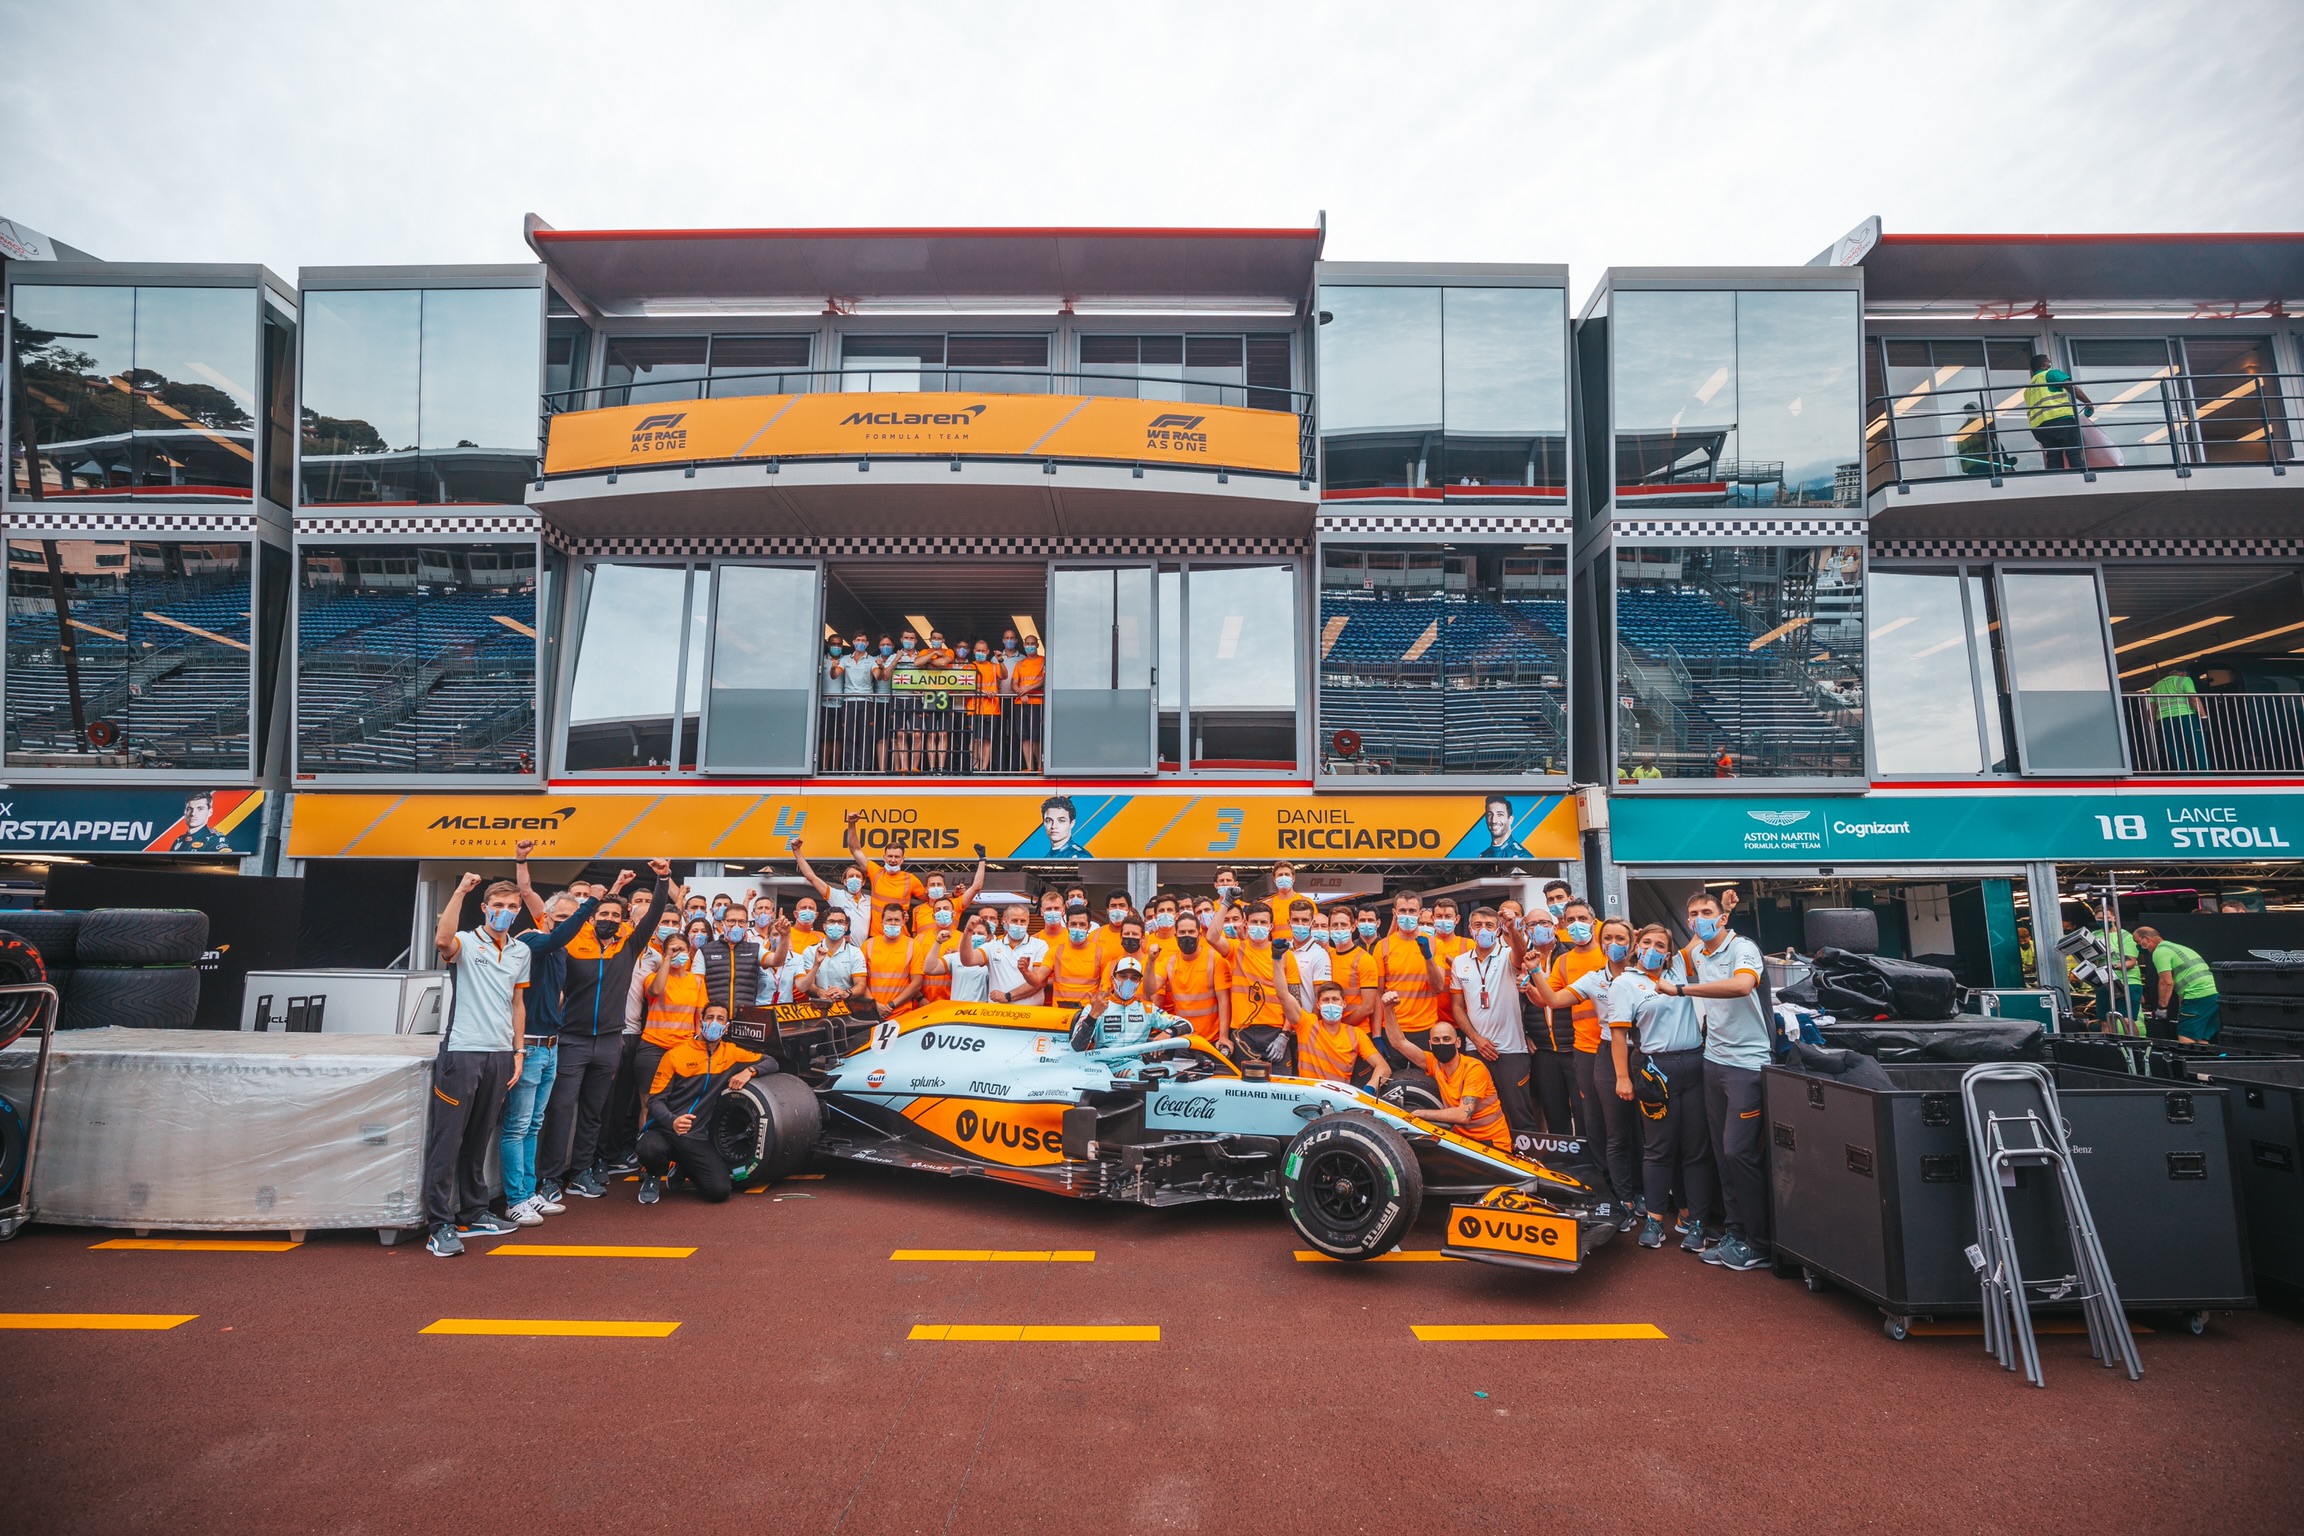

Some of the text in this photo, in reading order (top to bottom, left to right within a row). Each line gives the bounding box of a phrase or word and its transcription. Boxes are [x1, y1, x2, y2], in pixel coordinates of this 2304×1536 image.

[839, 412, 970, 426] McLaren
[631, 430, 687, 443] WE RACE
[1147, 429, 1207, 442] WE RACE
[630, 439, 686, 453] AS ONE
[1147, 439, 1207, 452] AS ONE
[910, 675, 957, 685] LANDO
[923, 691, 948, 709] P3
[0, 802, 14, 816] X
[844, 808, 918, 824] LANDO
[1277, 809, 1355, 824] DANIEL
[2166, 807, 2238, 822] LANCE
[426, 815, 559, 830] McLaren
[772, 806, 808, 851] 4
[1207, 808, 1245, 852] 3
[1833, 820, 1911, 838] Cognizant
[2094, 814, 2147, 840] 18
[0, 820, 153, 841] RSTAPPEN
[1744, 832, 1820, 841] ASTON MARTIN
[2170, 826, 2290, 848] STROLL
[1278, 828, 1441, 850] RICCIARDO
[1610, 895, 1616, 903] 6
[955, 1008, 1032, 1020] DELL Technologies
[734, 1024, 762, 1039] Hilton
[878, 1023, 896, 1050] 4
[867, 1074, 886, 1082] Gulf
[1225, 1088, 1301, 1102] RICHARD MILLE
[1153, 1094, 1219, 1120] Coca-Cola
[1294, 1129, 1333, 1157] ERO
[1361, 1200, 1400, 1249] PIRELLI
